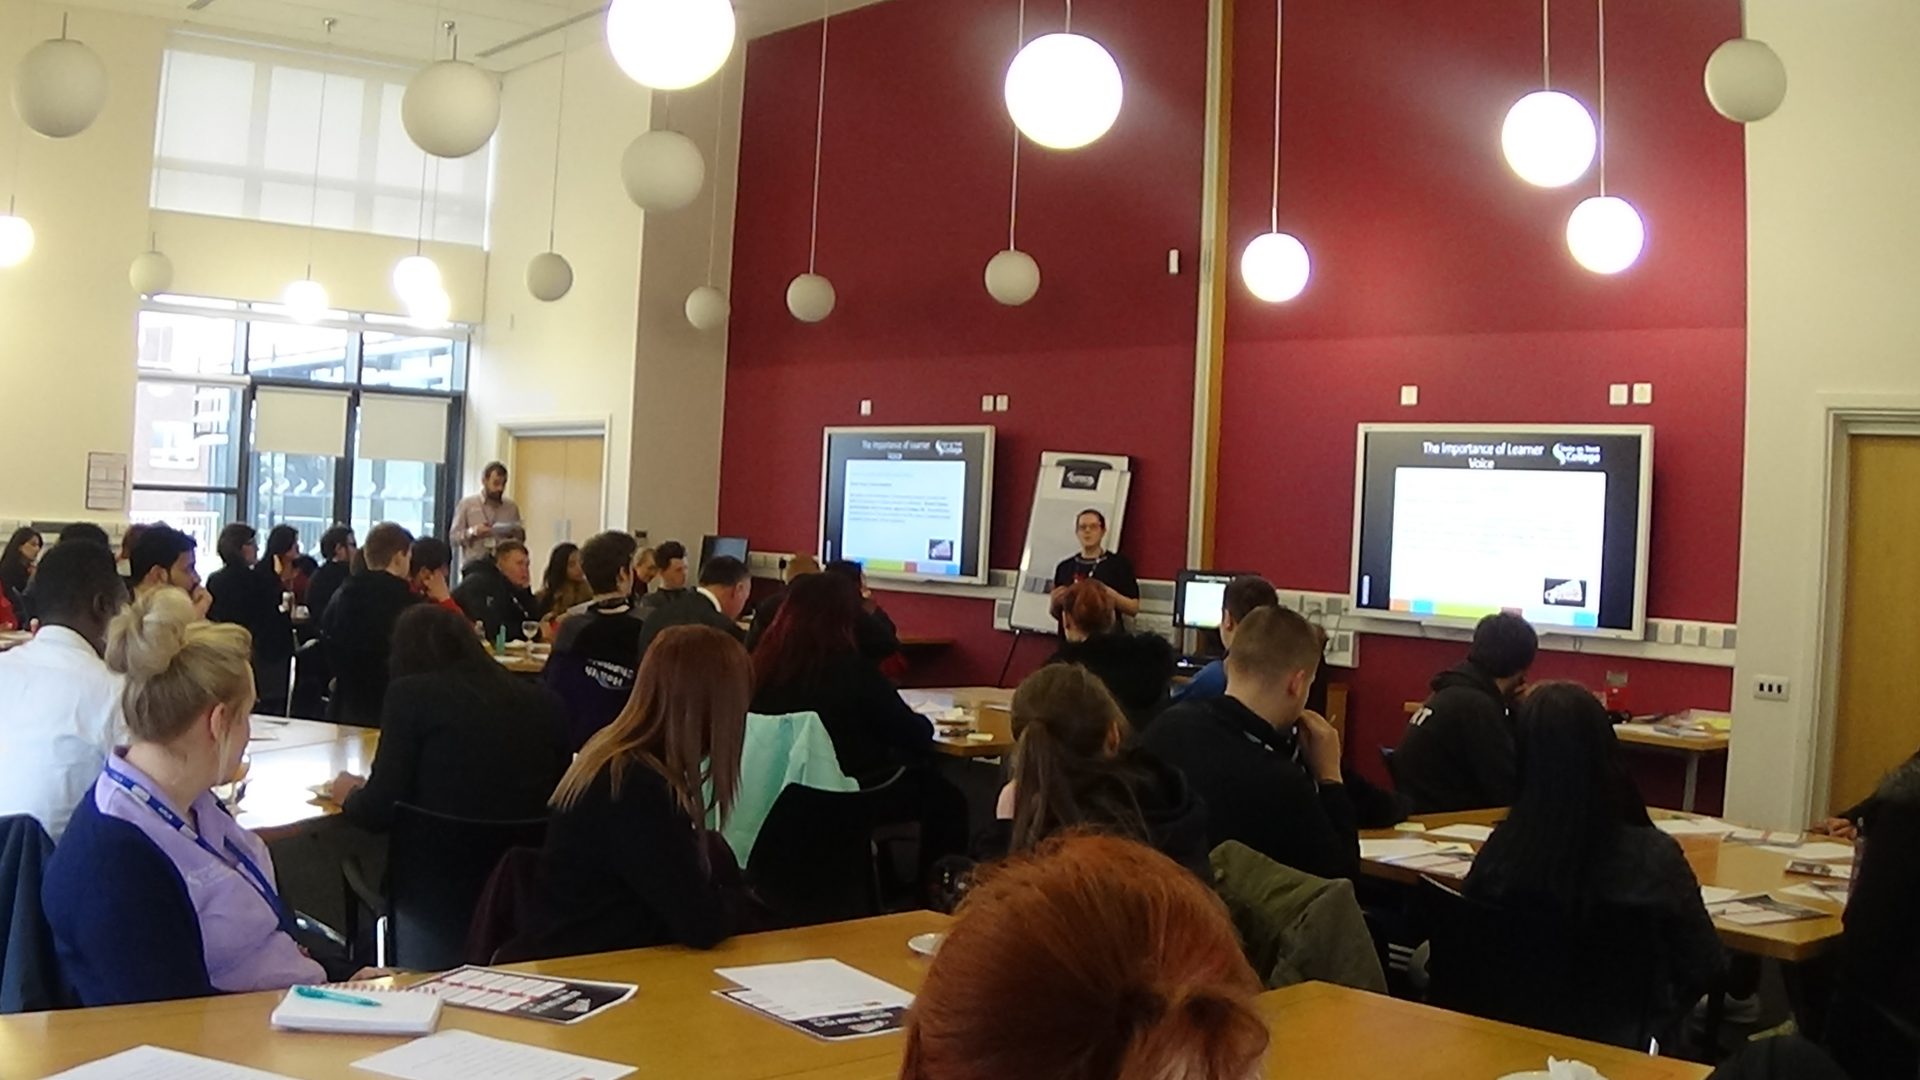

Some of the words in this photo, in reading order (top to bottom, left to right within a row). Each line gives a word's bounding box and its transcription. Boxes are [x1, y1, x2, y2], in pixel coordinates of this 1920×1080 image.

[1423, 442, 1440, 454] The
[1441, 442, 1494, 456] Importance
[1495, 442, 1506, 455] of
[1507, 443, 1544, 456] Learner
[1468, 457, 1495, 469] Voice
